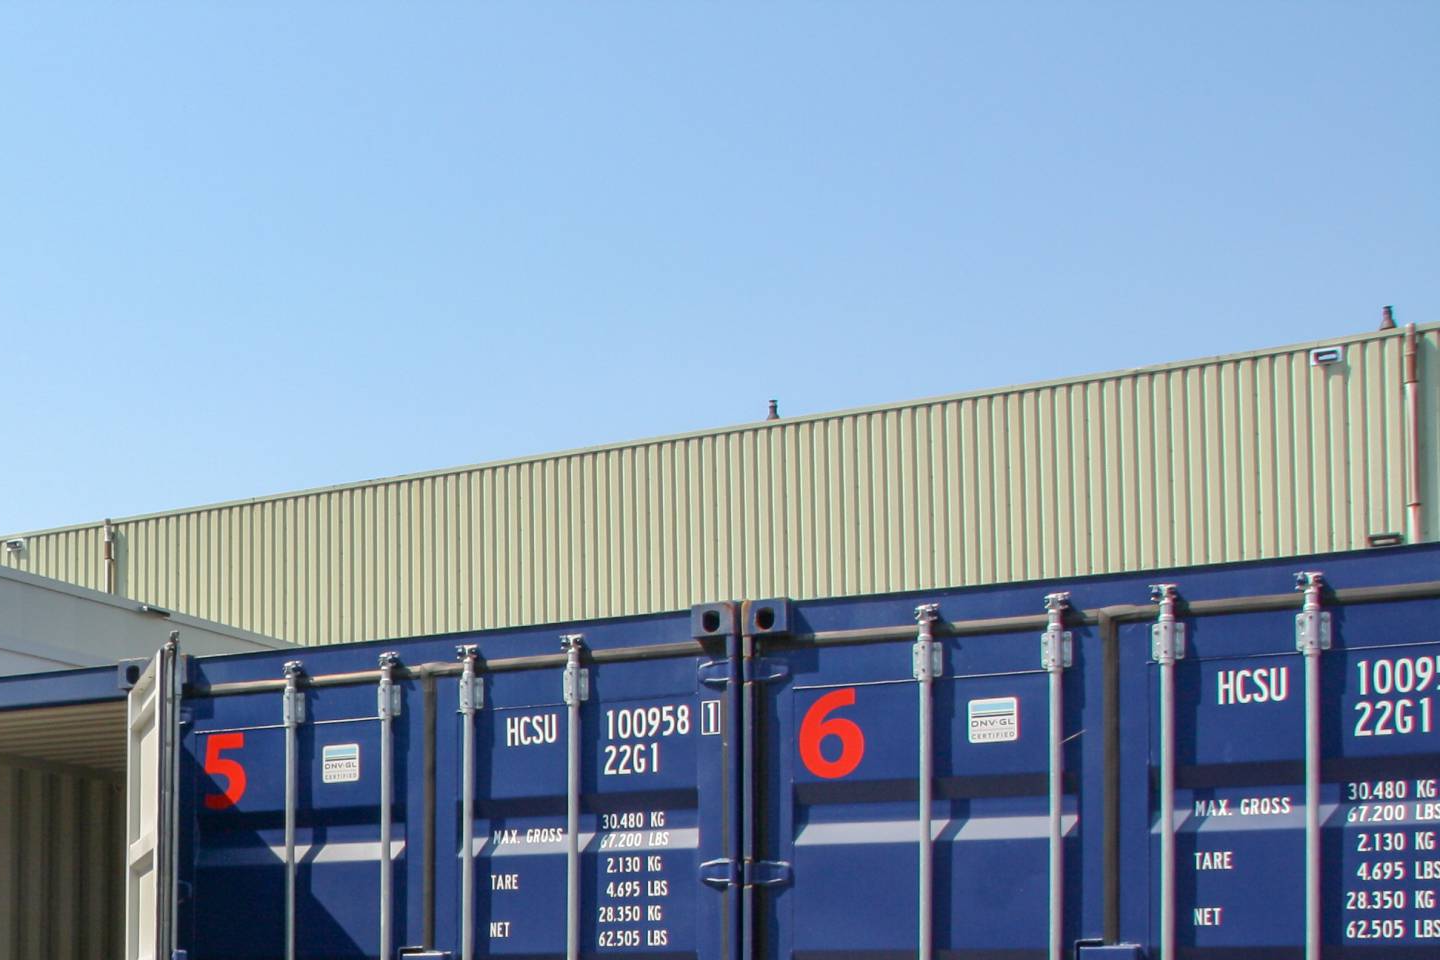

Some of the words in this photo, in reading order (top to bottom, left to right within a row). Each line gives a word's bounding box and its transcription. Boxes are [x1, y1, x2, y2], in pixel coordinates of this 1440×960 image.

[1217, 667, 1288, 705] HCSU
[1357, 656, 1440, 696] 1009
[506, 714, 557, 747] HCSU
[606, 704, 690, 740] 100958
[1354, 697, 1433, 737] 22G1
[799, 687, 865, 779] 6
[971, 731, 1015, 740] CERTIFIED
[604, 743, 659, 775] 22G1
[204, 732, 247, 810] 5
[325, 772, 357, 780] CERTIFIED
[1348, 781, 1406, 800] 30.480
[1416, 780, 1437, 798] KG
[1195, 799, 1232, 816] MAX.
[1240, 797, 1291, 815] GROSS
[1347, 805, 1405, 822] 67.200
[1415, 803, 1440, 820] LBS
[602, 813, 644, 829] 30.480
[650, 812, 665, 827] KG
[493, 830, 520, 845] MAX.
[526, 828, 564, 844] GROSS
[601, 833, 642, 849] 67.200
[649, 831, 669, 846] LBS
[1357, 833, 1405, 851] 2.130
[1415, 832, 1436, 850] KG
[607, 857, 640, 873] 2.130
[647, 856, 662, 872] KG
[1194, 852, 1233, 870] TARE
[1357, 861, 1405, 880] 4.695
[1415, 861, 1440, 879] LBS
[491, 874, 519, 890] TARE
[606, 881, 640, 897] 4.695
[647, 880, 667, 896] LBS
[1346, 891, 1405, 909] 28.350
[1415, 890, 1436, 909] KG
[599, 906, 640, 922] 28.350
[647, 905, 662, 921] KG
[1193, 907, 1222, 926] NET
[489, 922, 511, 938] NET
[1346, 920, 1405, 938] 62.505
[1415, 919, 1440, 938] LBS
[599, 930, 640, 947] 62.505
[647, 930, 667, 946] LBS
